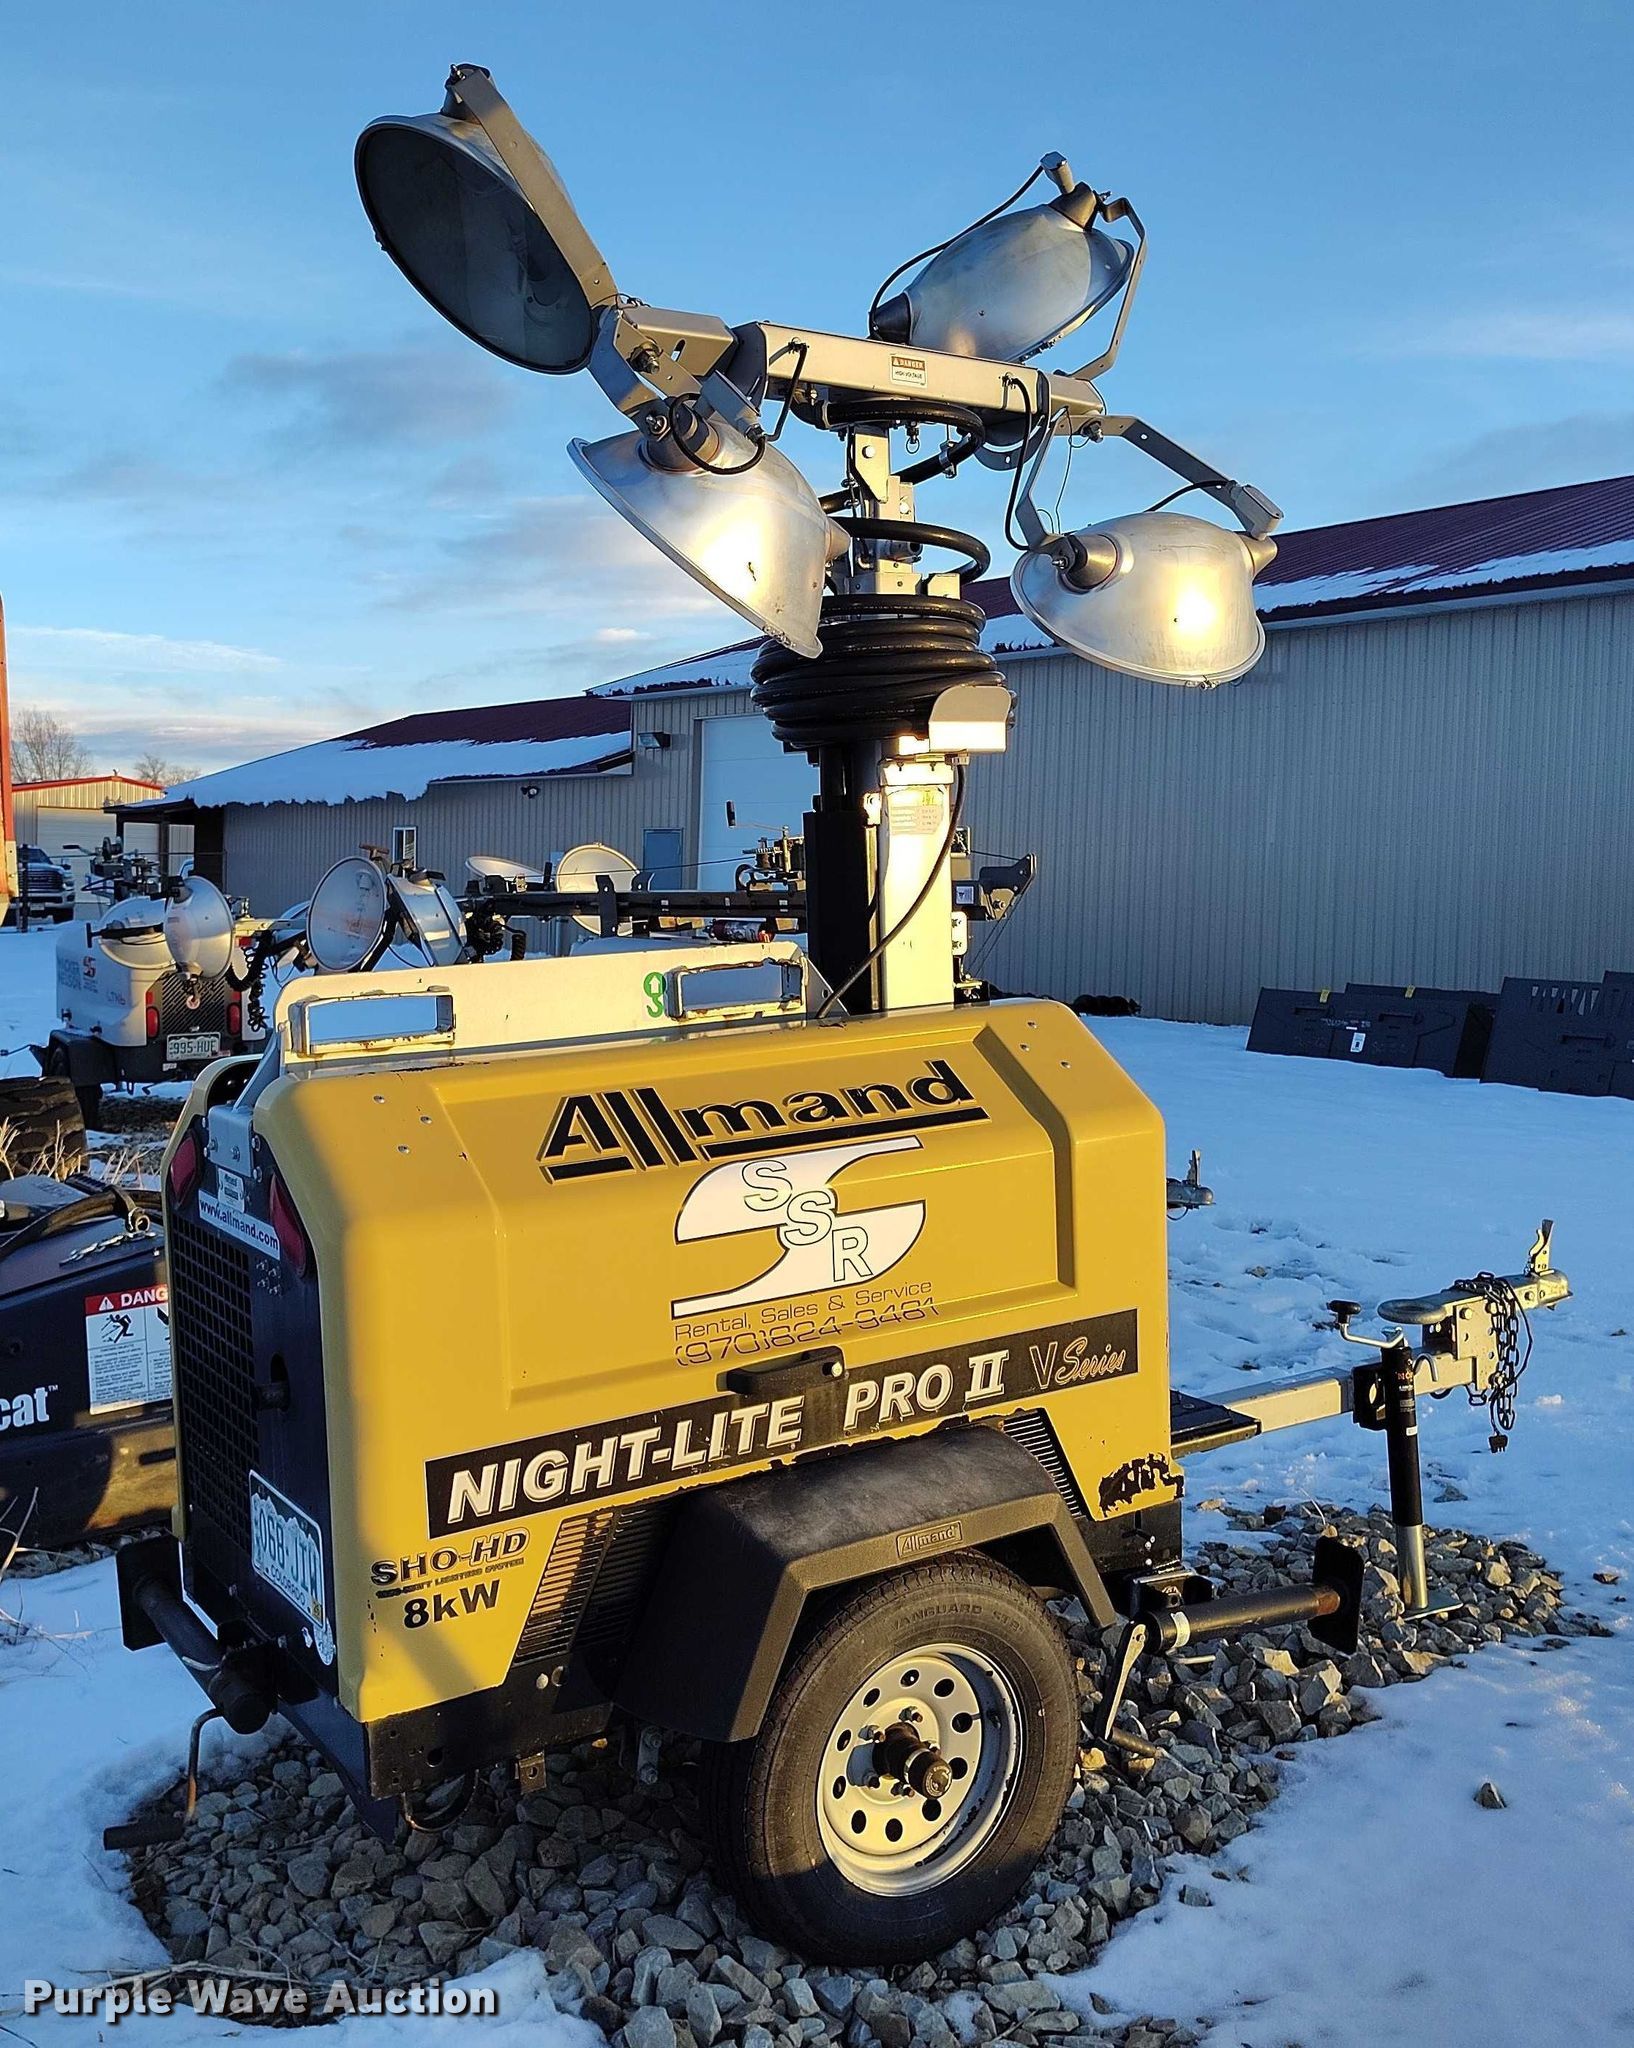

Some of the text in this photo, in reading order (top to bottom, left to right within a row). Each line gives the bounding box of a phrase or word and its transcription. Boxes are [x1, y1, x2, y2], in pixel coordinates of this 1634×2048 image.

[537, 1059, 979, 1173] Allmand
[200, 1200, 279, 1249] www.allmand.com
[674, 1280, 932, 1341] Rental, Sales & Service
[1029, 1335, 1127, 1390] V Series
[447, 1348, 1010, 1524] NIGHT-LITE PRO II
[370, 1527, 530, 1586] SHO-HD
[902, 1525, 956, 1554] Allmand
[270, 1564, 306, 1606] COLORADO
[403, 1578, 500, 1629] 8kW
[891, 1603, 983, 1630] VANGUARD
